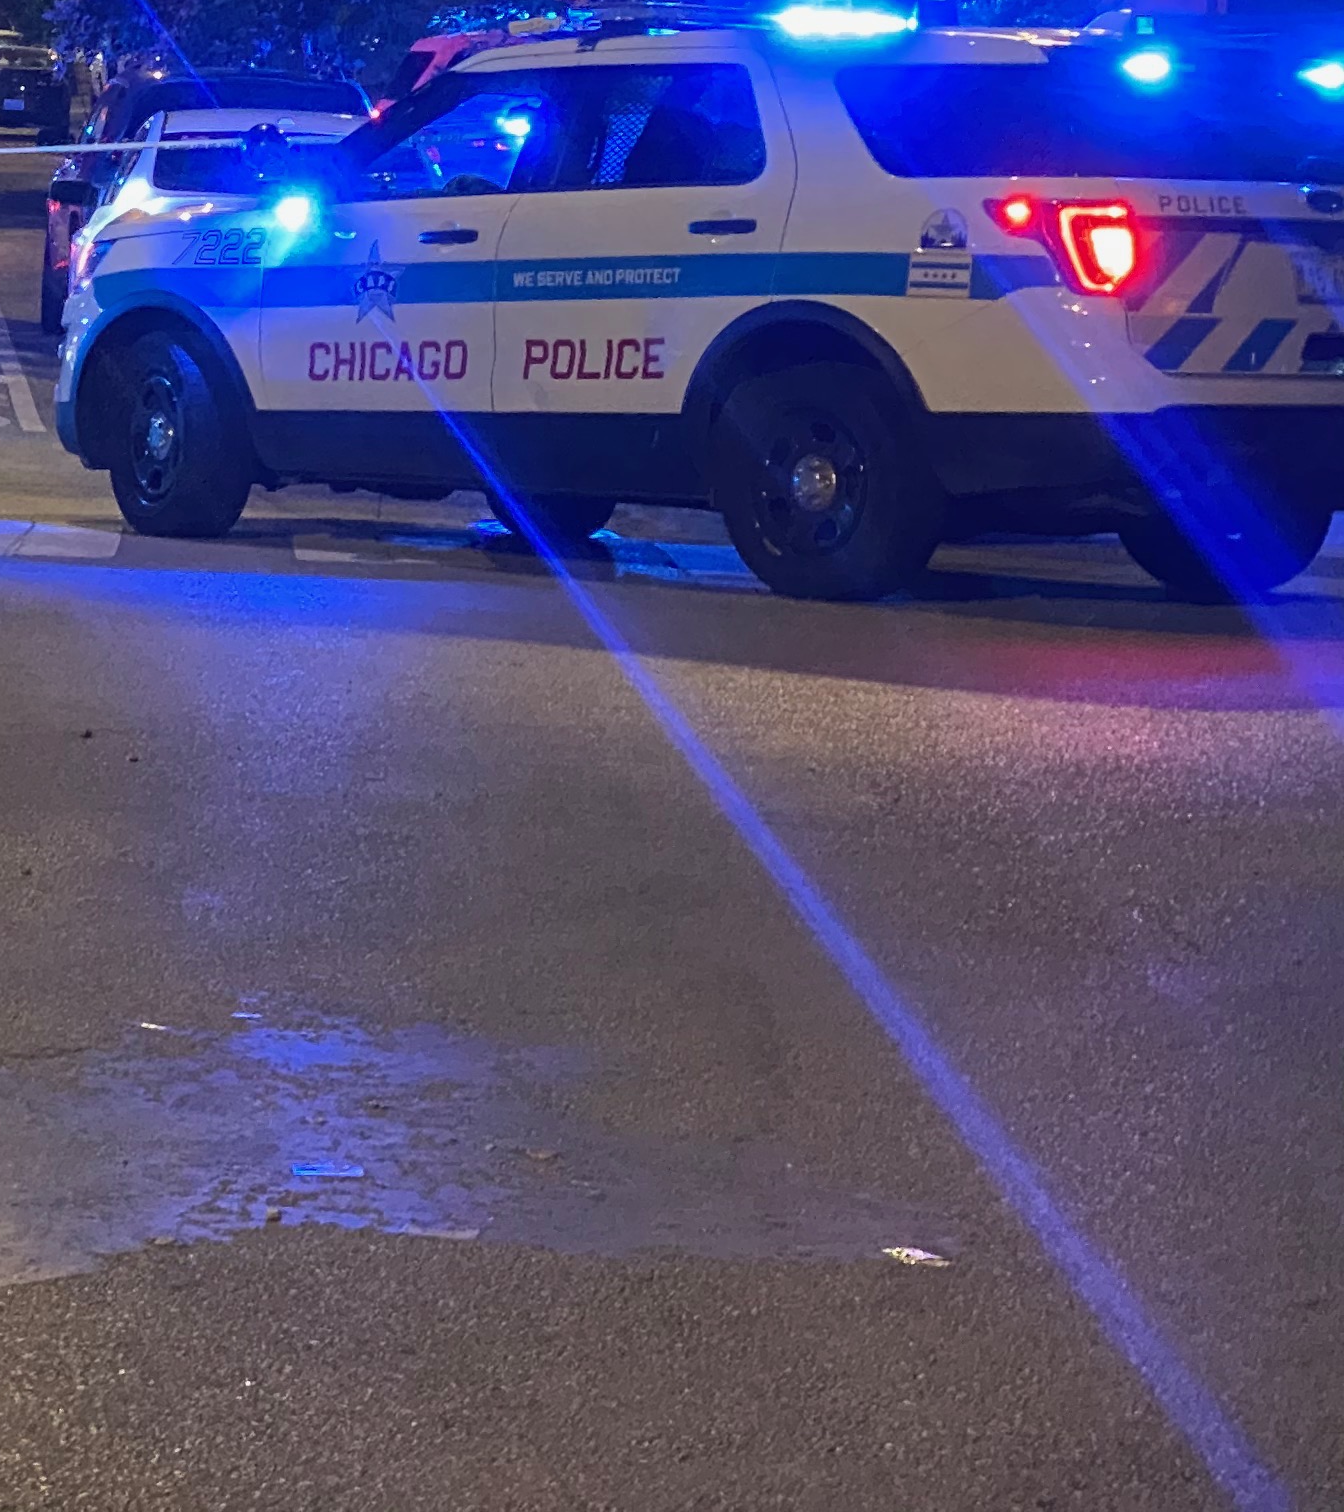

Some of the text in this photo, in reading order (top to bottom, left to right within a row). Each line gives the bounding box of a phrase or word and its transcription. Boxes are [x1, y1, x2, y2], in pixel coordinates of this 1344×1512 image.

[1158, 194, 1248, 214] POLICE
[172, 227, 266, 265] 7222
[513, 268, 681, 287] WE SERVE AND PROTECT
[308, 337, 666, 381] CHICAGO POLICE
